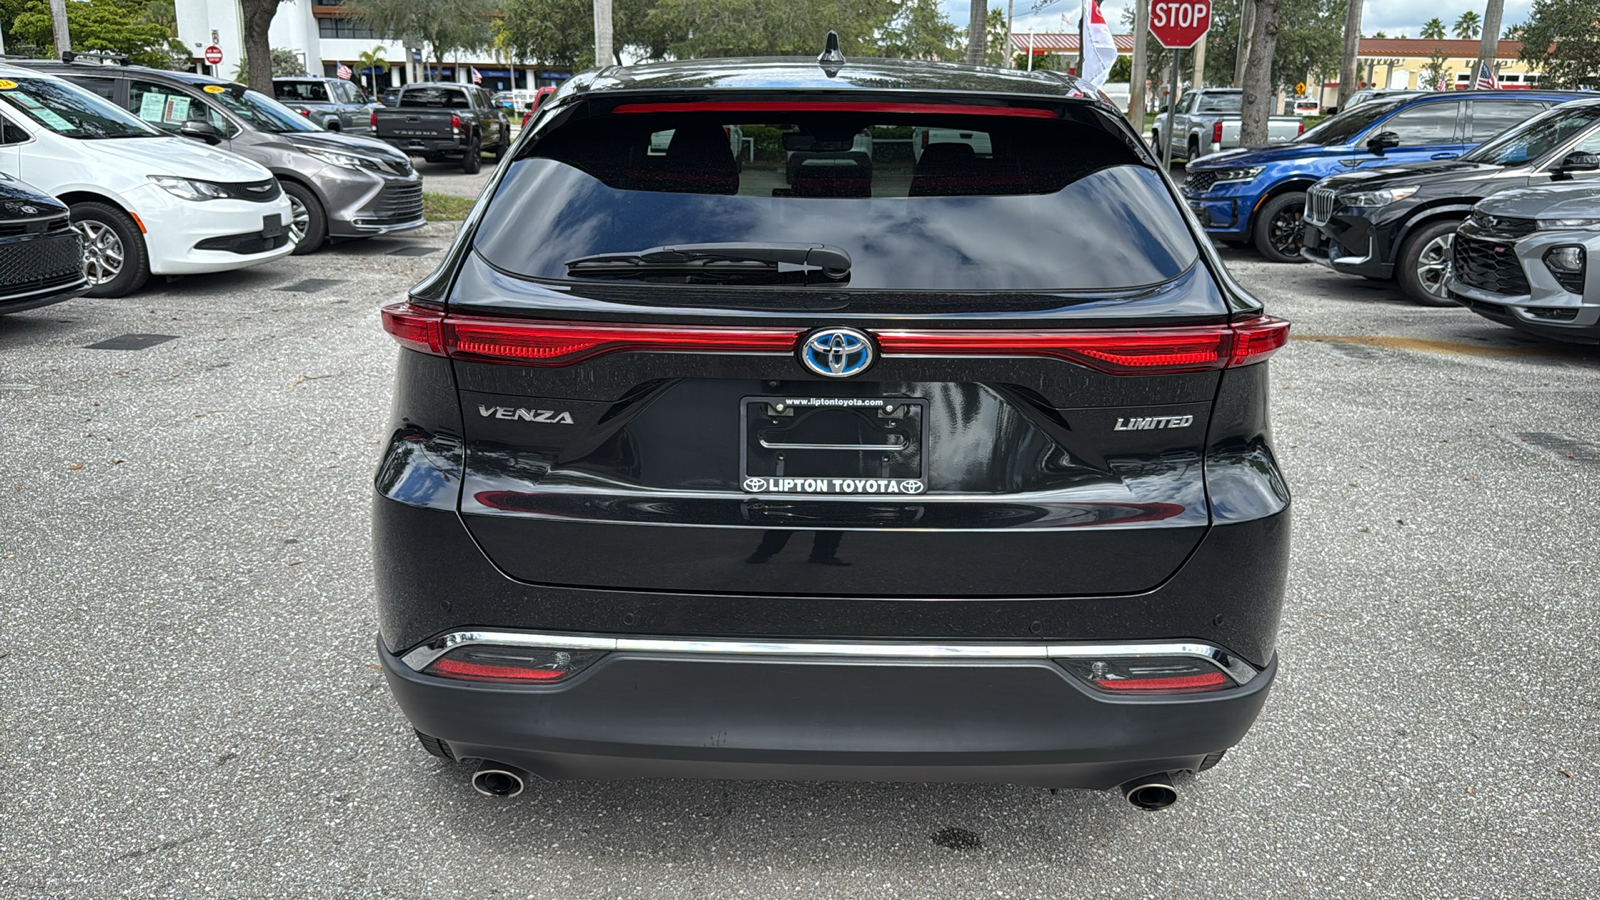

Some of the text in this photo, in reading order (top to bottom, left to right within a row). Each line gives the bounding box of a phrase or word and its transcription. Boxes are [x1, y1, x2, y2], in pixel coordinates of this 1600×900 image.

[1153, 3, 1207, 27] STOP
[785, 397, 884, 408] www.liptontoyota.com
[478, 403, 575, 425] VENZA
[1113, 415, 1194, 431] LIMITED
[769, 478, 899, 493] LIPTON TOYOTA
